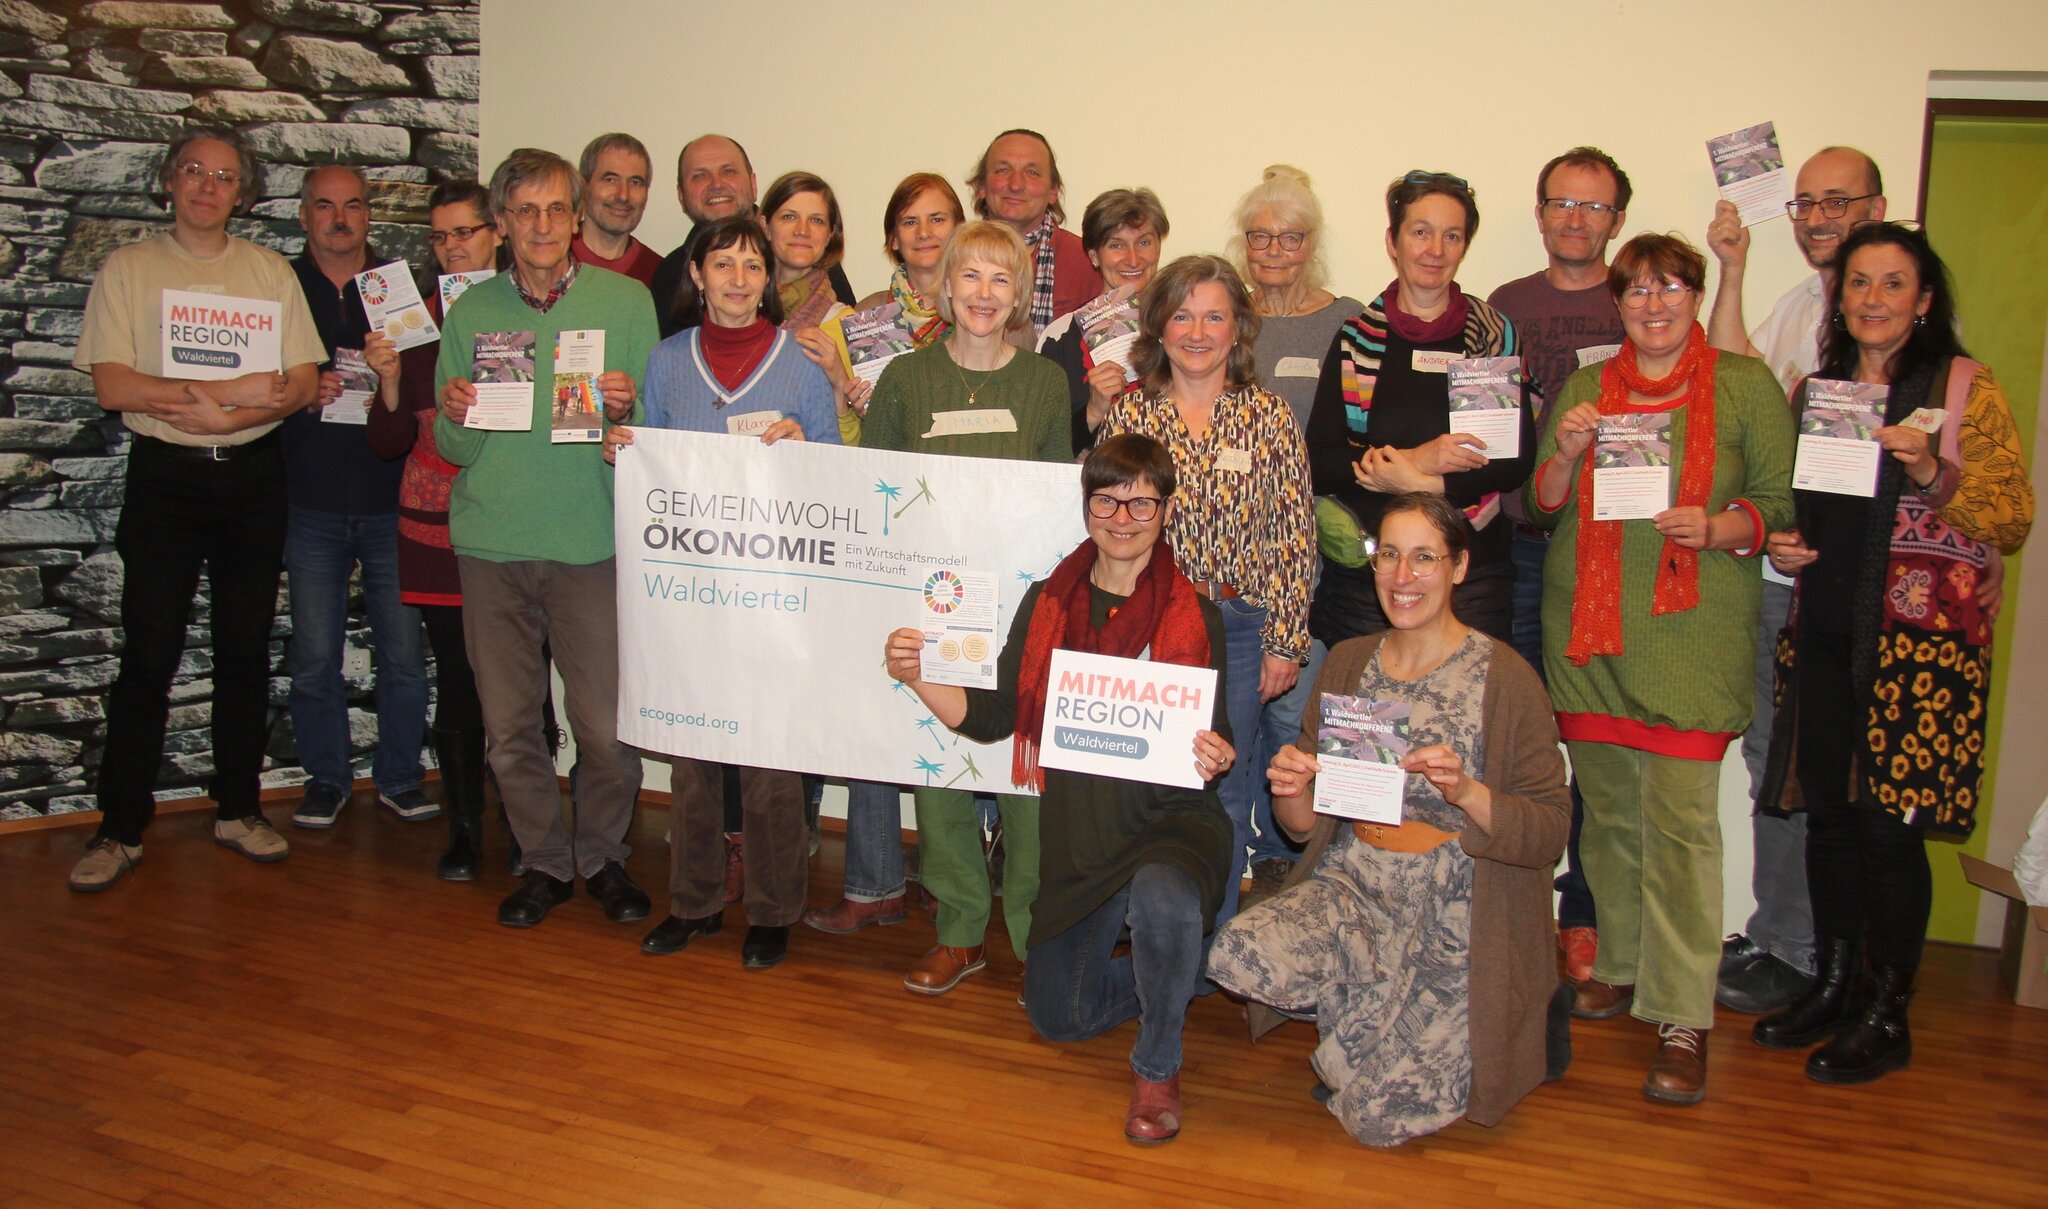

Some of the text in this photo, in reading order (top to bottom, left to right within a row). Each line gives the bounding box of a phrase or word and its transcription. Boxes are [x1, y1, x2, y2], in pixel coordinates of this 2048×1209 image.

[170, 304, 273, 332] MITMACH
[170, 324, 249, 348] REGION
[177, 350, 235, 365] Waldviertel
[954, 416, 1001, 428] MARIA
[646, 488, 868, 535] GEMEINWOHL
[643, 517, 836, 566] ÖKONOMIE
[845, 543, 968, 567] Ein Wirtschaftsmodell
[845, 560, 907, 576] mit Zukunft
[644, 573, 808, 612] Waldviertel
[1058, 670, 1202, 710] MITMACH
[639, 706, 739, 735] ecogood.org
[1056, 696, 1164, 733] REGION
[1324, 717, 1393, 734] MITMACHKONFERENZ
[1331, 709, 1372, 721] Waldviertler
[1063, 731, 1138, 754] Waldviertel
